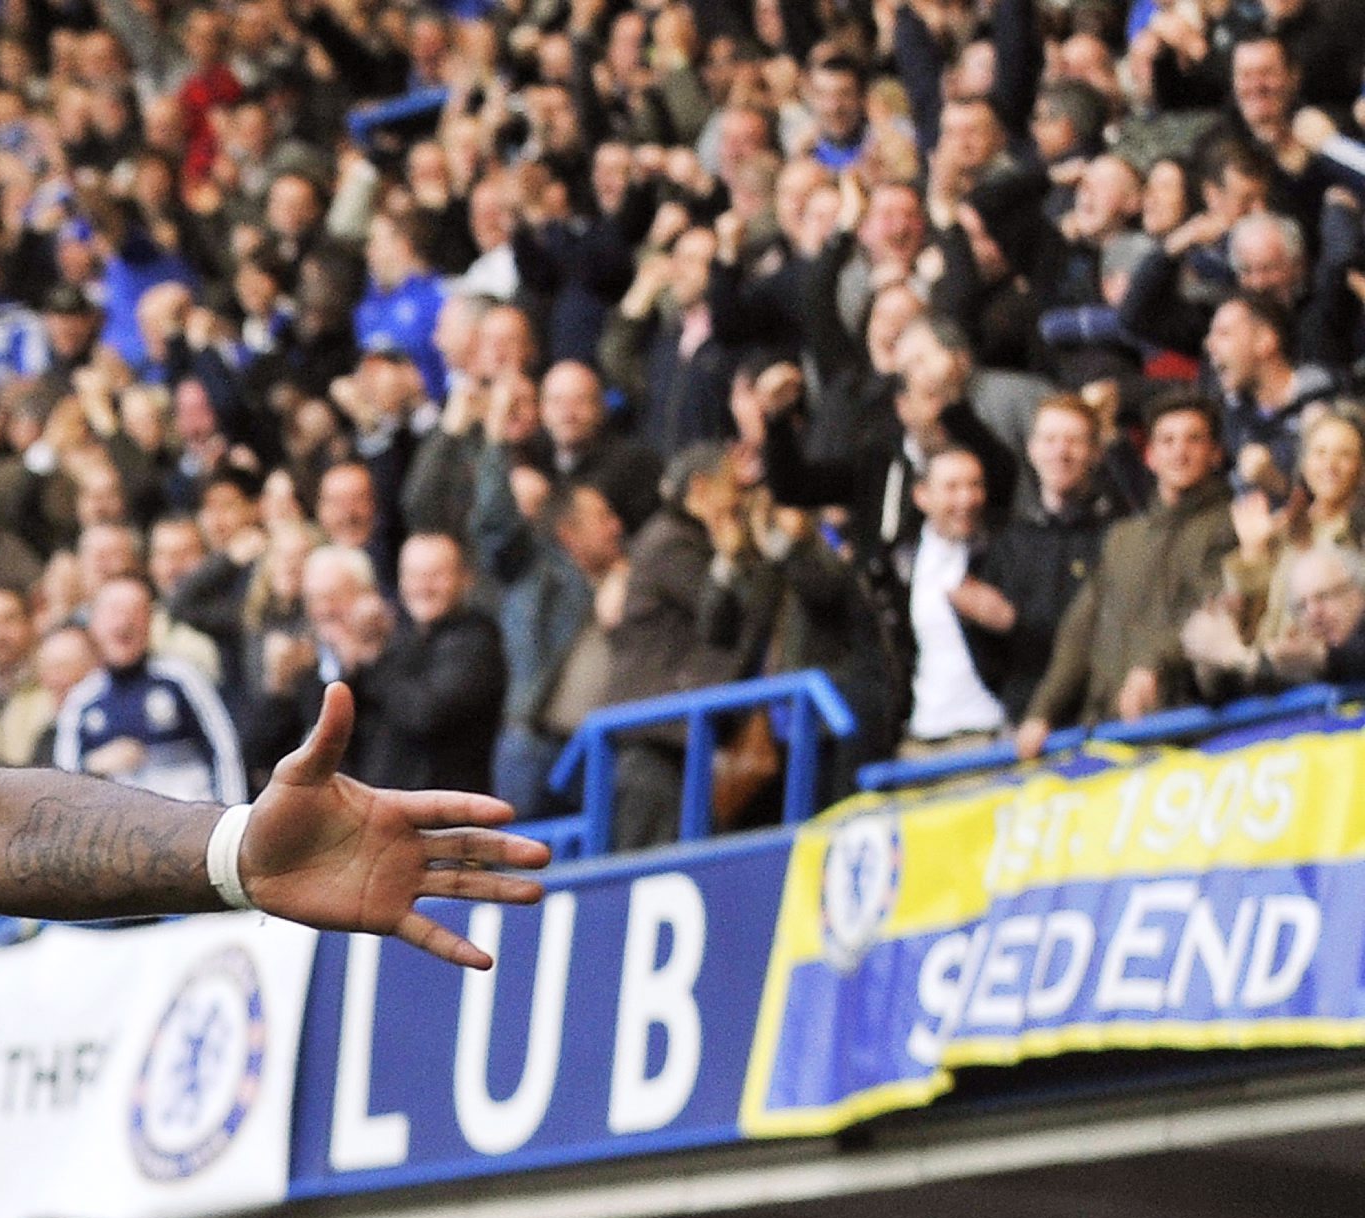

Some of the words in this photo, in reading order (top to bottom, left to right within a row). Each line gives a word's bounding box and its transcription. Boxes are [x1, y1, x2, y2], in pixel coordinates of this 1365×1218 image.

[1109, 752, 1301, 855] 1905
[1094, 880, 1323, 1012] END
[329, 874, 708, 1172] LUB
